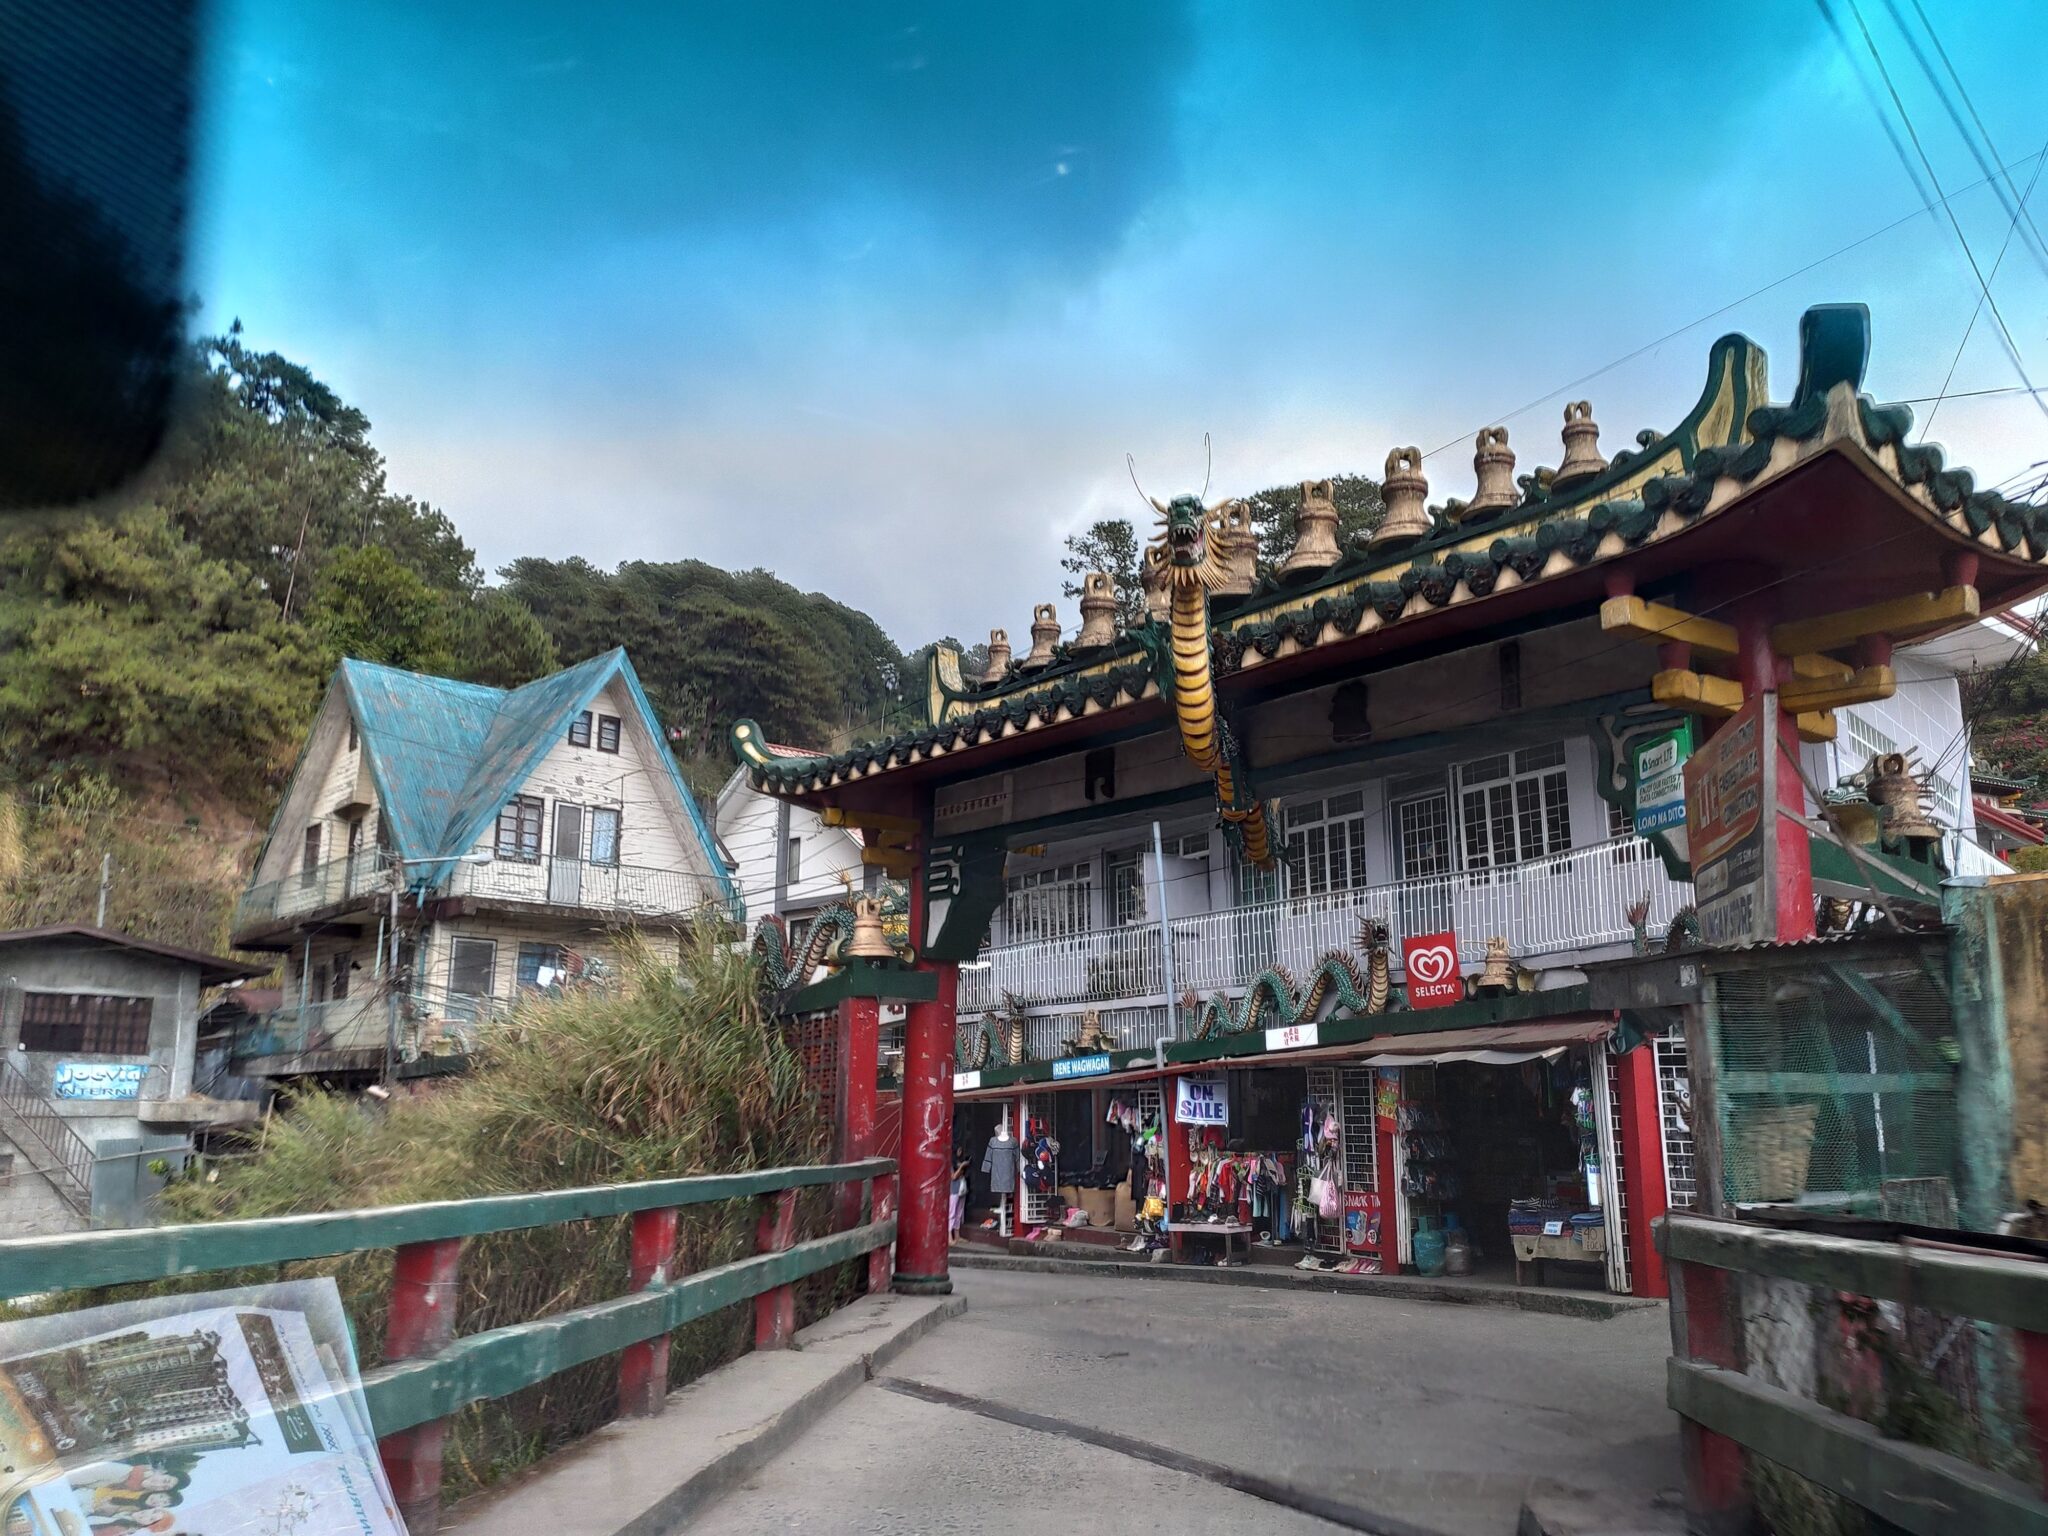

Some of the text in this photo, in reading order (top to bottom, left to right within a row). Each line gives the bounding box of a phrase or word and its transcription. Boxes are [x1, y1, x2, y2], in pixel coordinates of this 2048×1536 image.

[1648, 747, 1673, 769] Smart LTE
[1640, 784, 1653, 796] ENJOY
[1640, 792, 1651, 804] DATA
[1638, 804, 1687, 830] LOAD NA DITO
[1415, 984, 1454, 998] SELECTA
[1071, 1057, 1110, 1073] WAGWAGAN
[1190, 1084, 1214, 1101] ON
[1180, 1100, 1223, 1119] SALE
[1344, 1194, 1368, 1207] SNACK
[1583, 1227, 1597, 1241] 40
